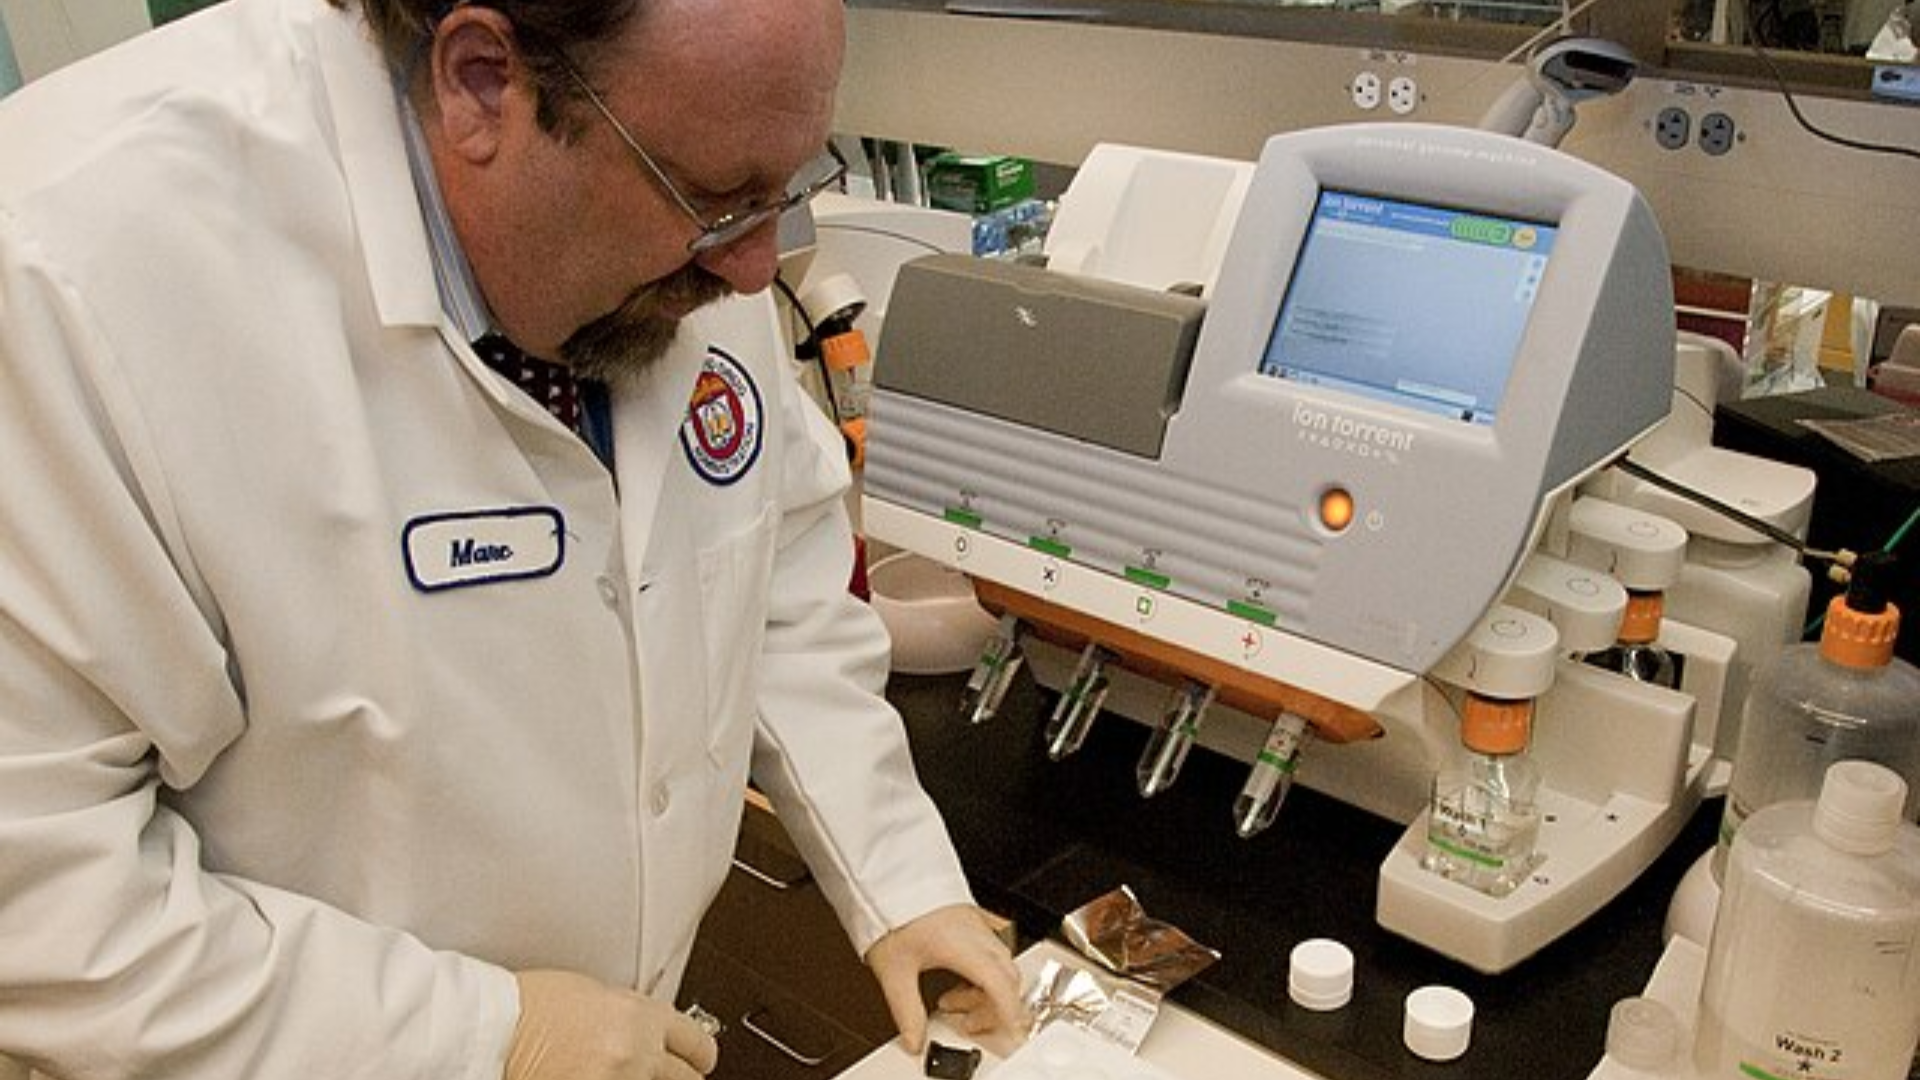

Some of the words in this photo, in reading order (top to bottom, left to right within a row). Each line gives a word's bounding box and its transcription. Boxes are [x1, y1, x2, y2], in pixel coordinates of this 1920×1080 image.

[1331, 414, 1415, 450] torrent
[451, 538, 513, 567] Marc
[1775, 1034, 1826, 1060] Wash
[1829, 1048, 1843, 1063] 2
